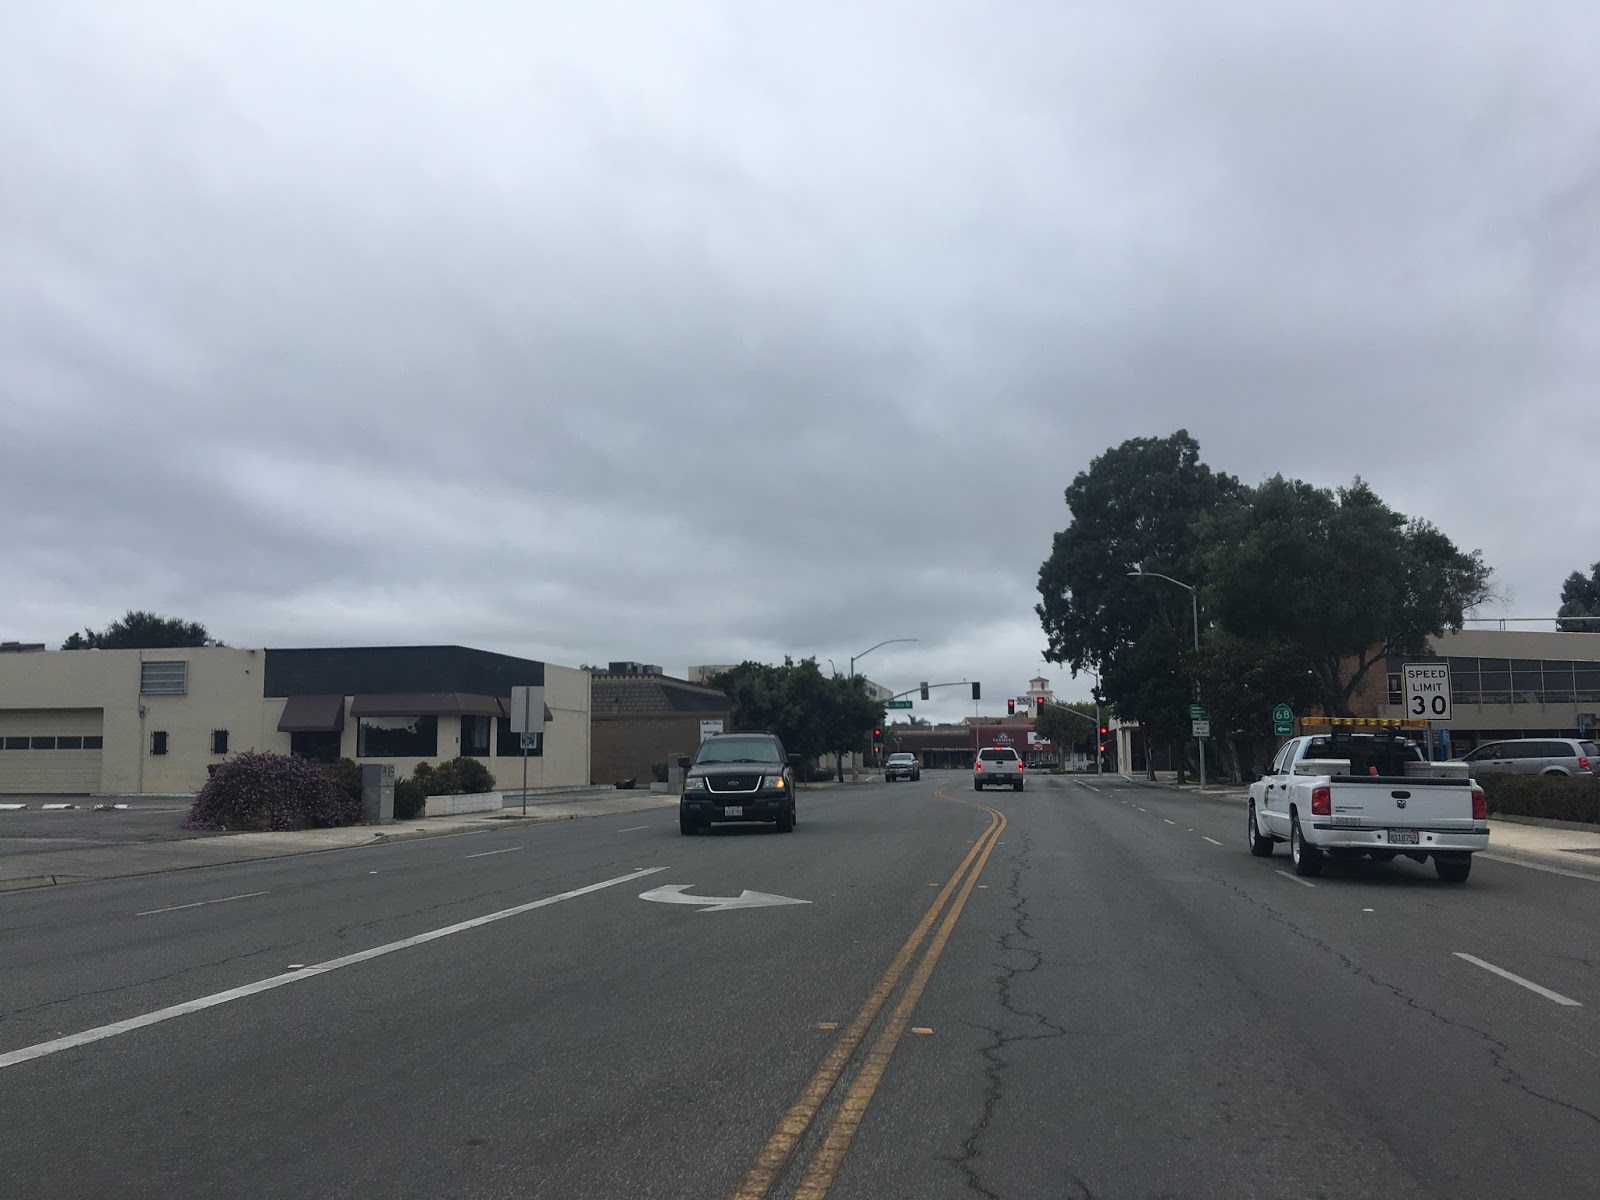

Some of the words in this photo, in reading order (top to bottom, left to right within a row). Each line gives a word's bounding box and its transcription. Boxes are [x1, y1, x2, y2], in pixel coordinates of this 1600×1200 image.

[1408, 670, 1446, 678] SPEED
[1412, 683, 1442, 691] LIMIT
[1412, 695, 1446, 715] 30
[1276, 710, 1290, 719] 68
